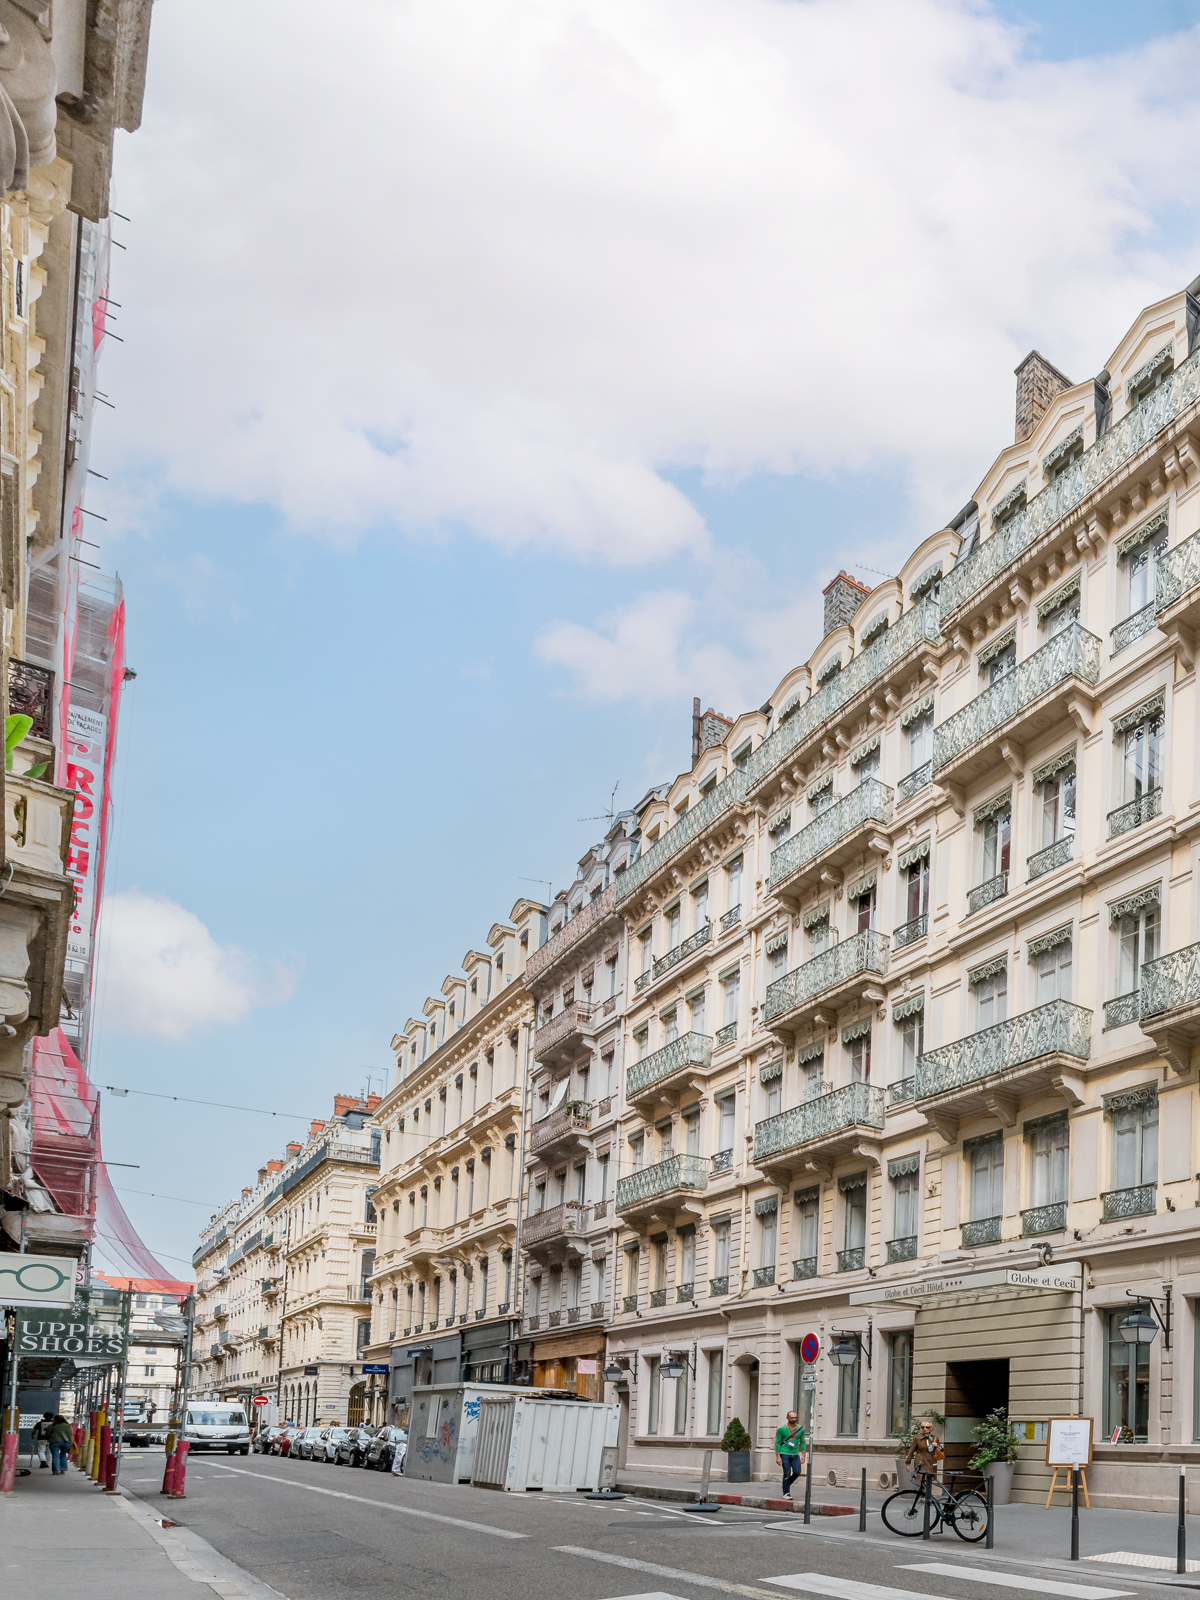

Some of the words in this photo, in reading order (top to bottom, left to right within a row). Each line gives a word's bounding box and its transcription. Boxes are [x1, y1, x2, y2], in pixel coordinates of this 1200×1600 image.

[76, 721, 102, 734] FAÇADES
[1011, 1273, 1038, 1284] Globe
[1042, 1278, 1051, 1286] et
[1054, 1278, 1077, 1289] Cecil
[885, 1289, 901, 1298] Globe
[903, 1288, 908, 1296] et
[910, 1284, 925, 1295] Cecil
[927, 1282, 944, 1293] Hôtel
[21, 1320, 124, 1340] UPPER
[20, 1335, 123, 1354] SHOES
